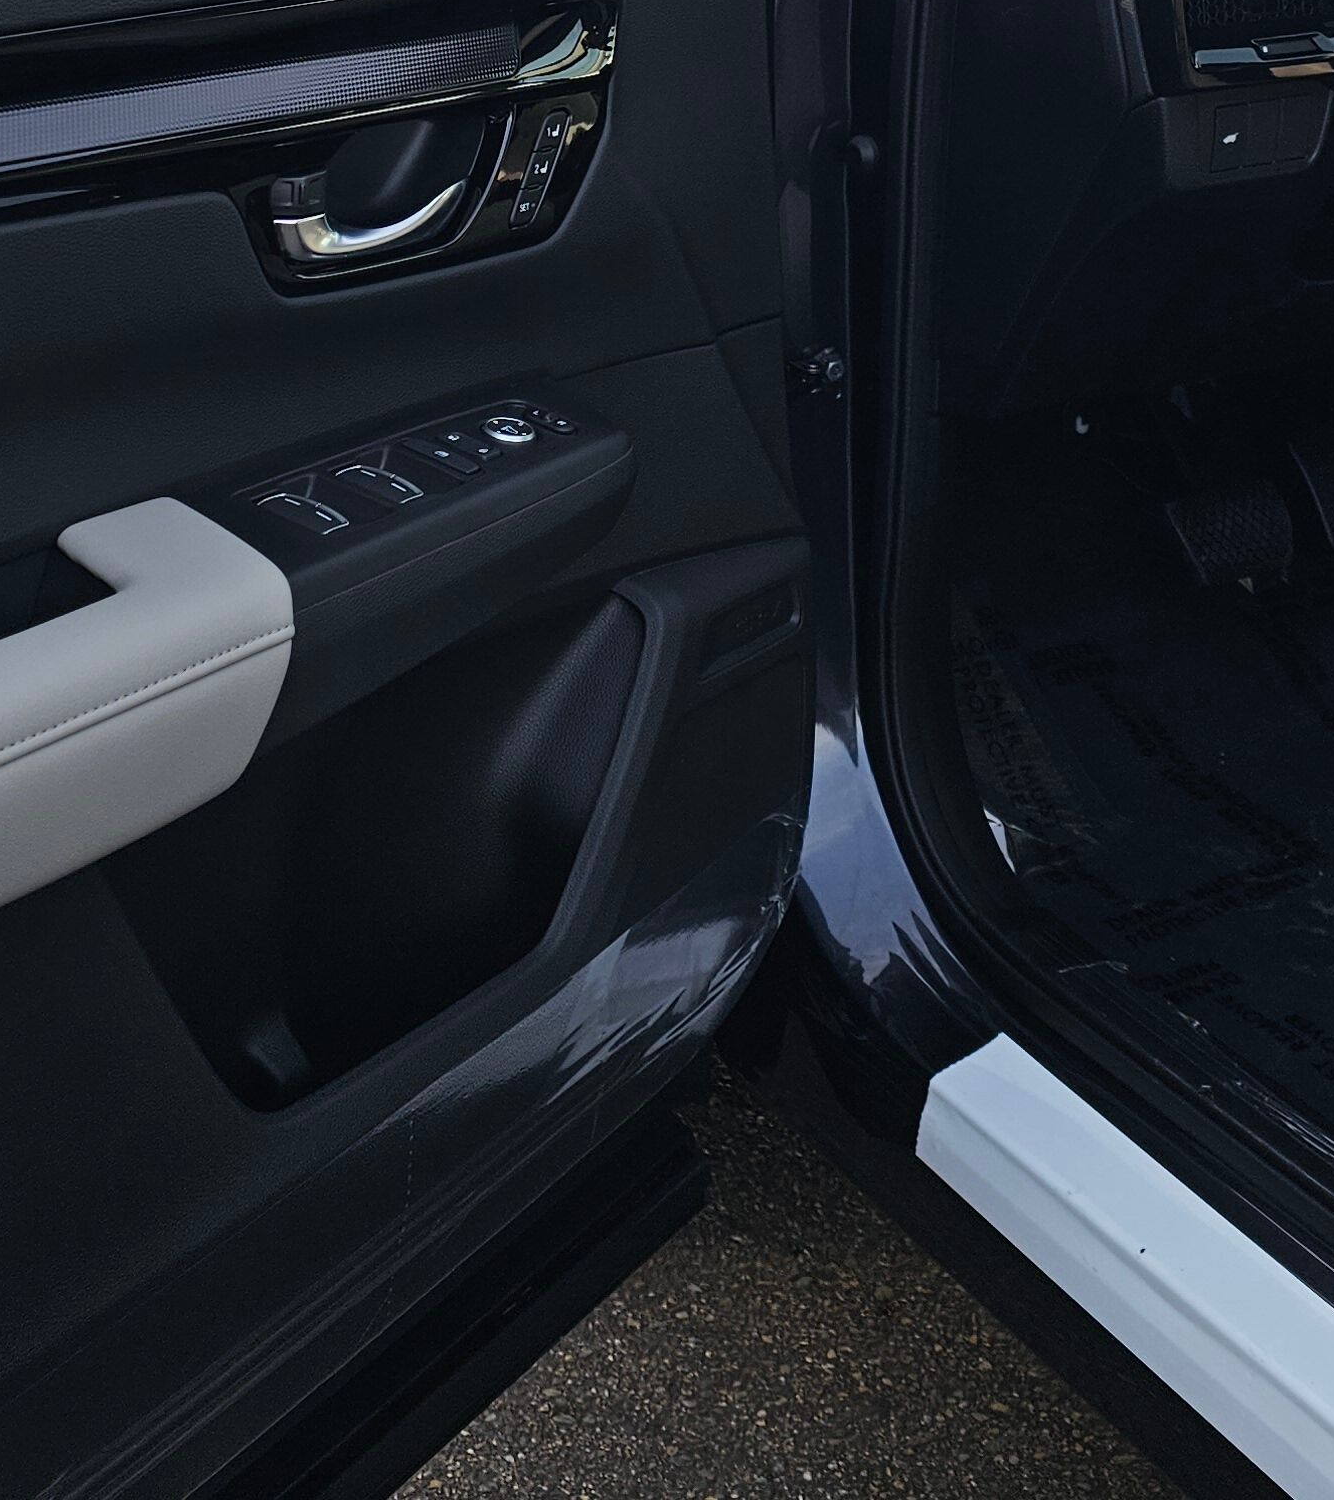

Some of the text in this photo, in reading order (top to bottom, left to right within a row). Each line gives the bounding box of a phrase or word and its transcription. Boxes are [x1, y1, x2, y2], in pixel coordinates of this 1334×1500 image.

[546, 126, 552, 138] 1
[533, 163, 540, 175] 2
[519, 202, 530, 213] SET
